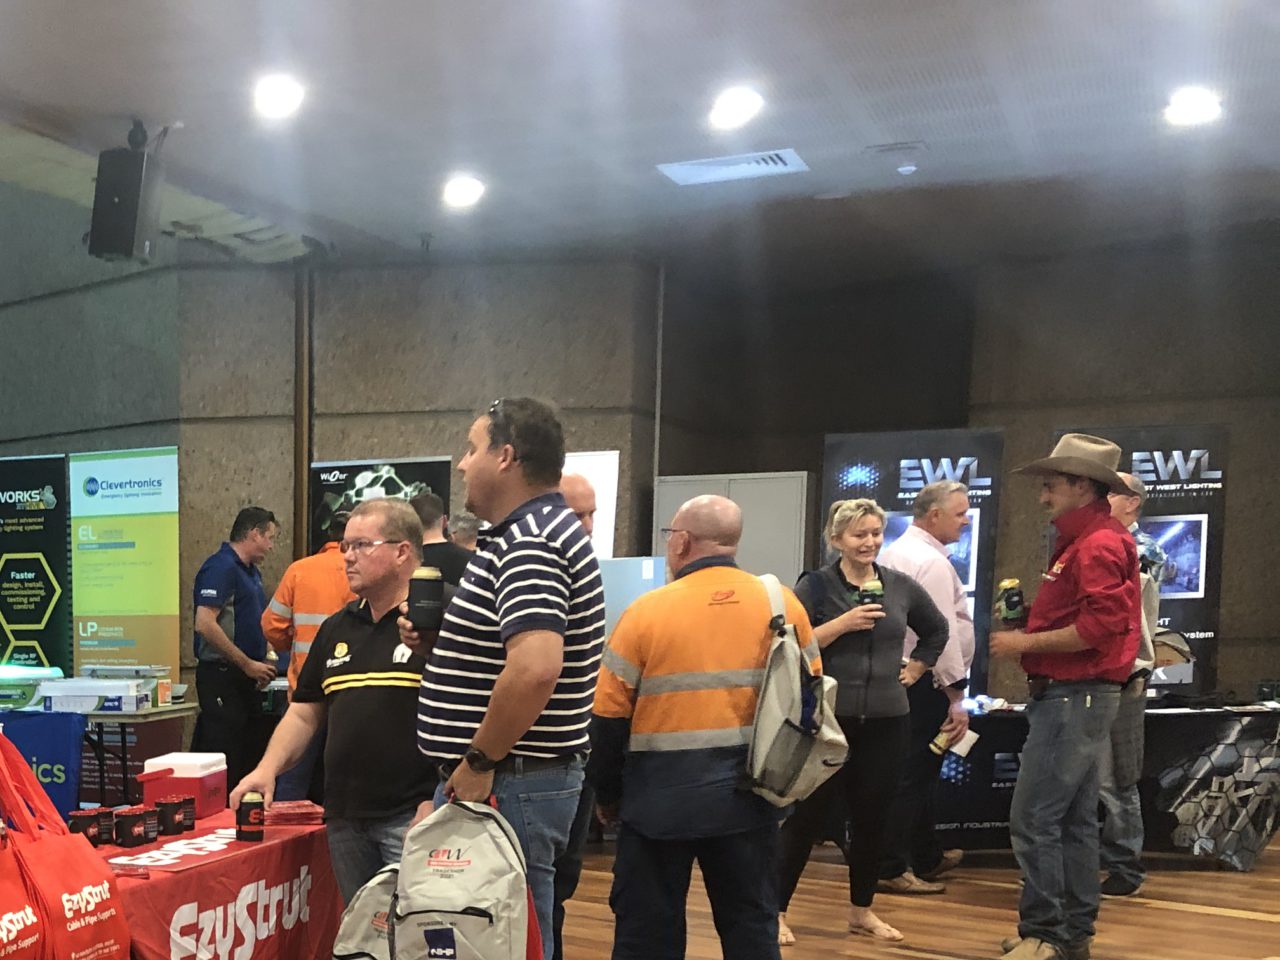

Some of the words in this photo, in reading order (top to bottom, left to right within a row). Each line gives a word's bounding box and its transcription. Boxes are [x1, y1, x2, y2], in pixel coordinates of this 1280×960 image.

[899, 456, 992, 489] EWL
[1131, 449, 1223, 481] EWL
[100, 478, 162, 490] Clevertronics
[78, 525, 97, 540] EL
[10, 571, 36, 580] Faster
[78, 621, 98, 637] LP
[61, 880, 111, 919] EzyStrut
